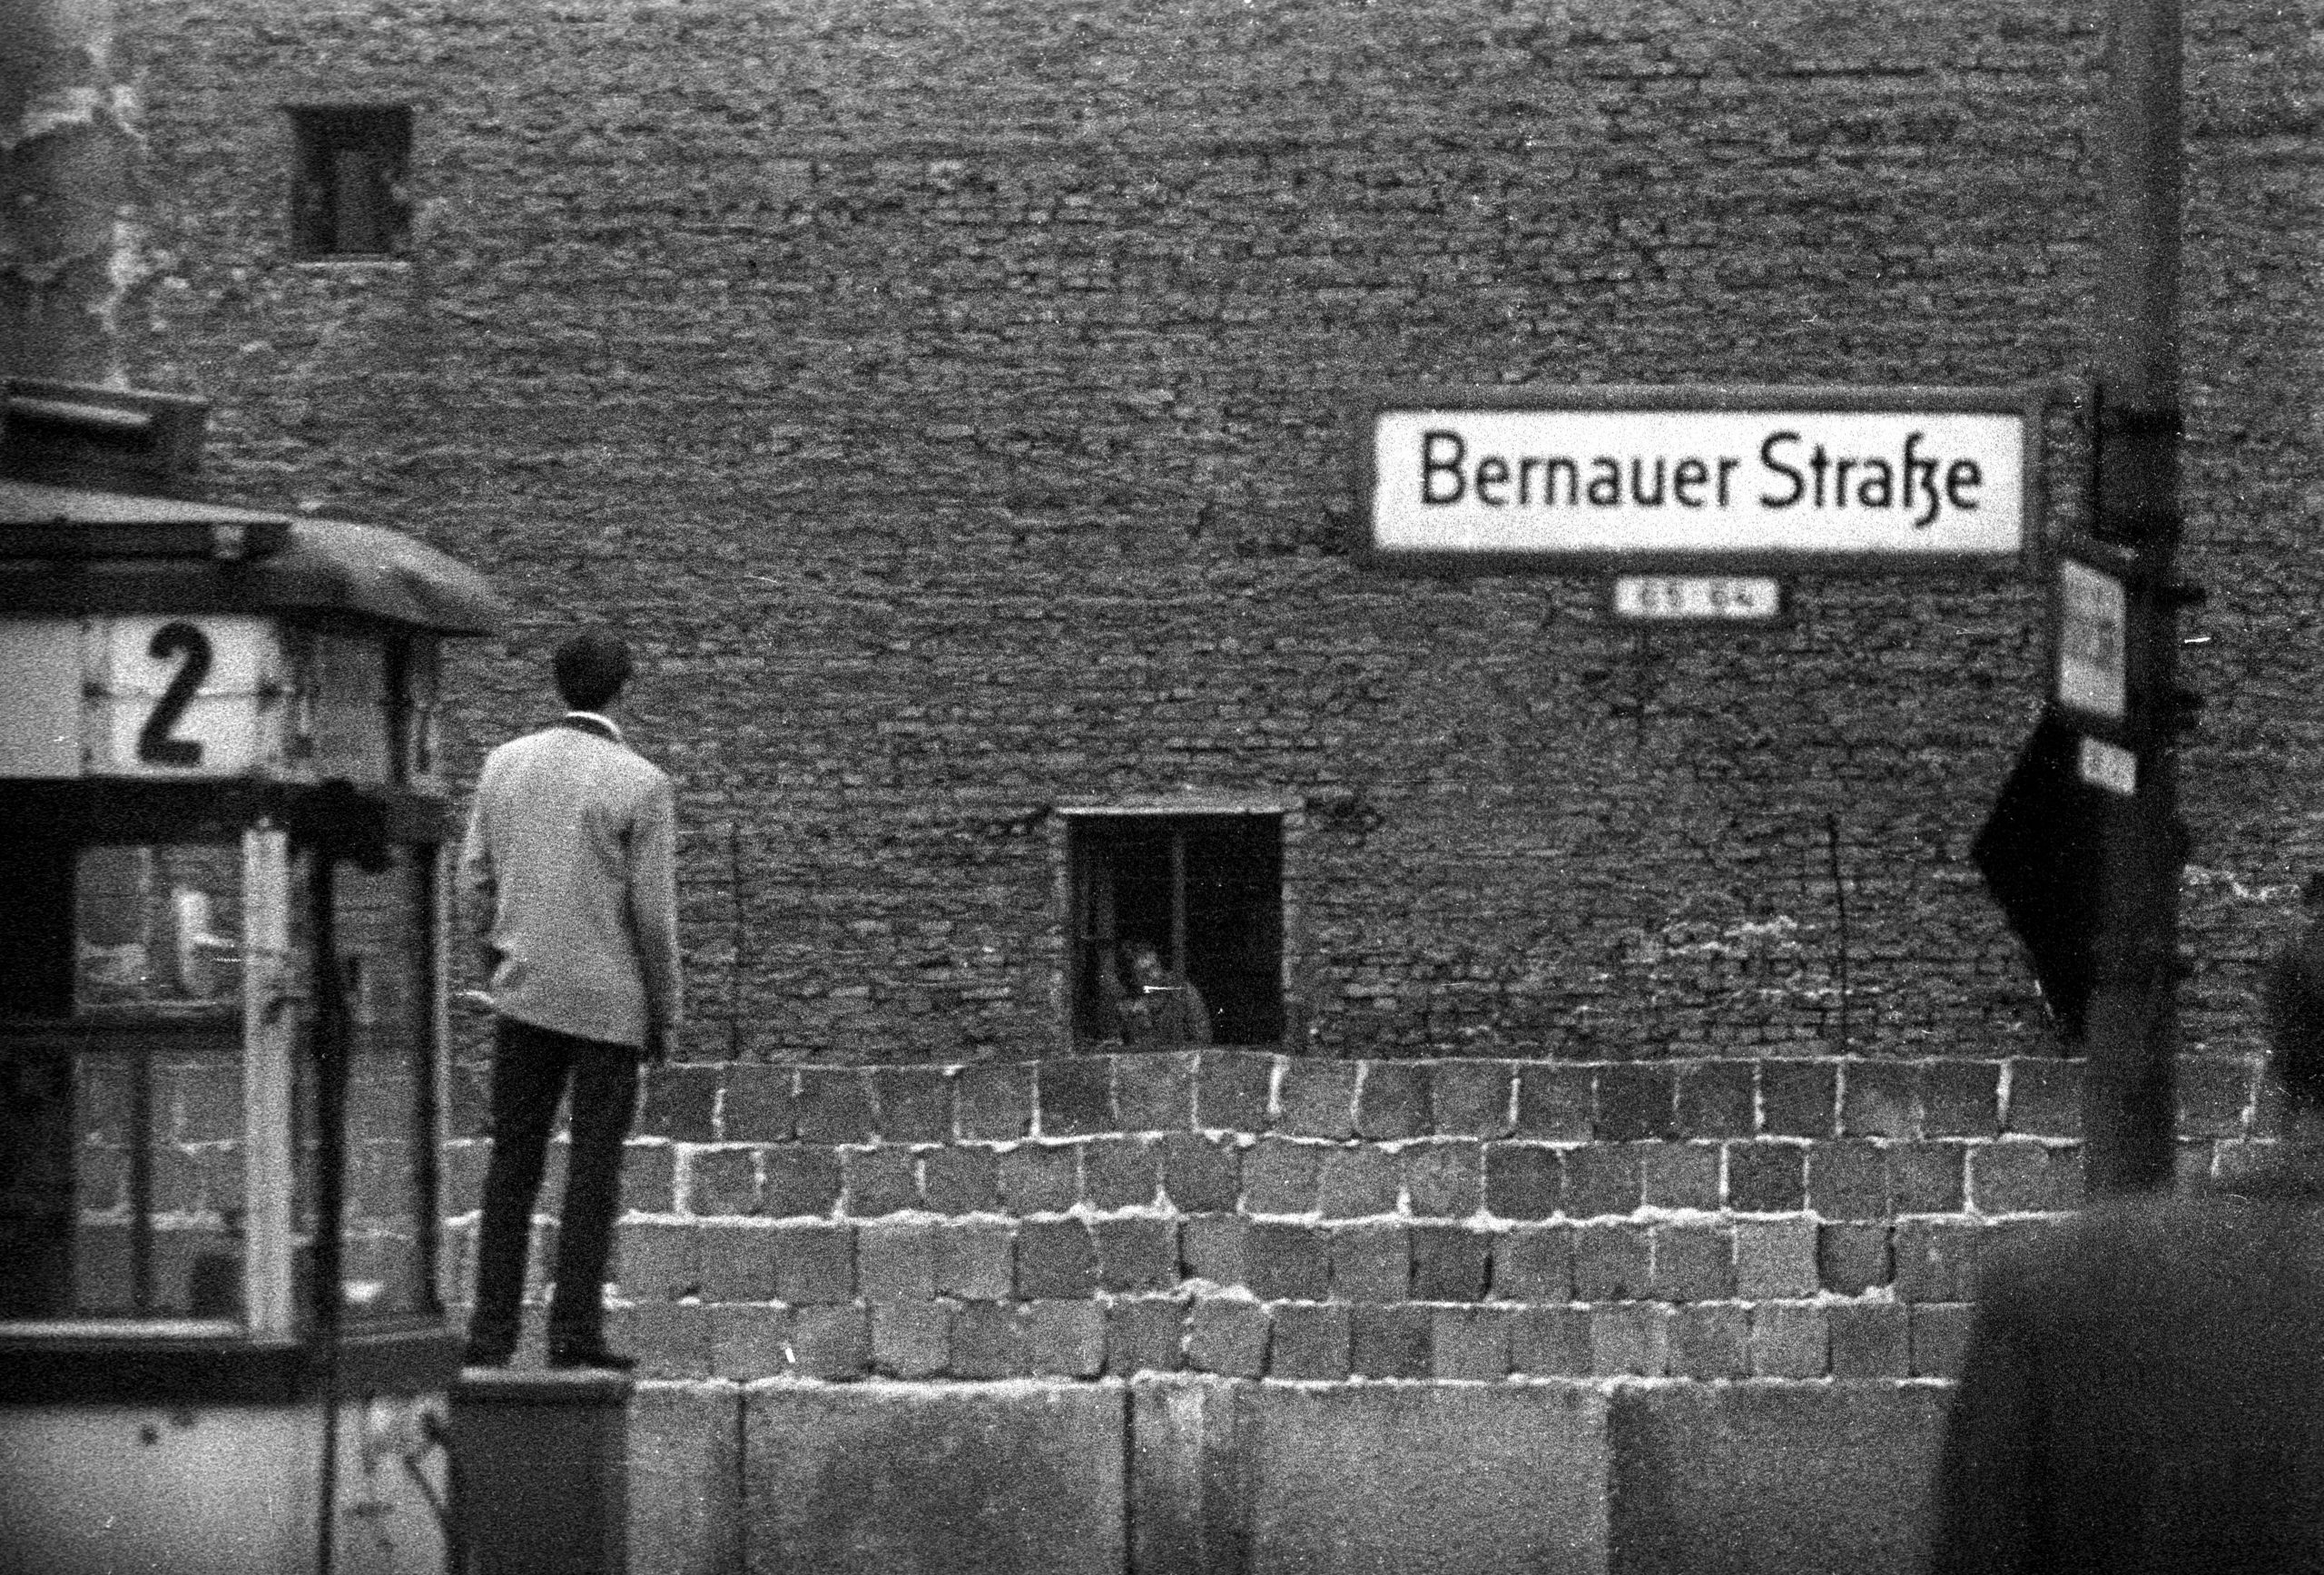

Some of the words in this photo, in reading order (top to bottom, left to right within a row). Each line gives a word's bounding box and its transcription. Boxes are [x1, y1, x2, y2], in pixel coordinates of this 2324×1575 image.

[1421, 429, 1738, 507] Bernauer
[1759, 430, 1983, 529] Straße
[136, 620, 214, 768] 2
